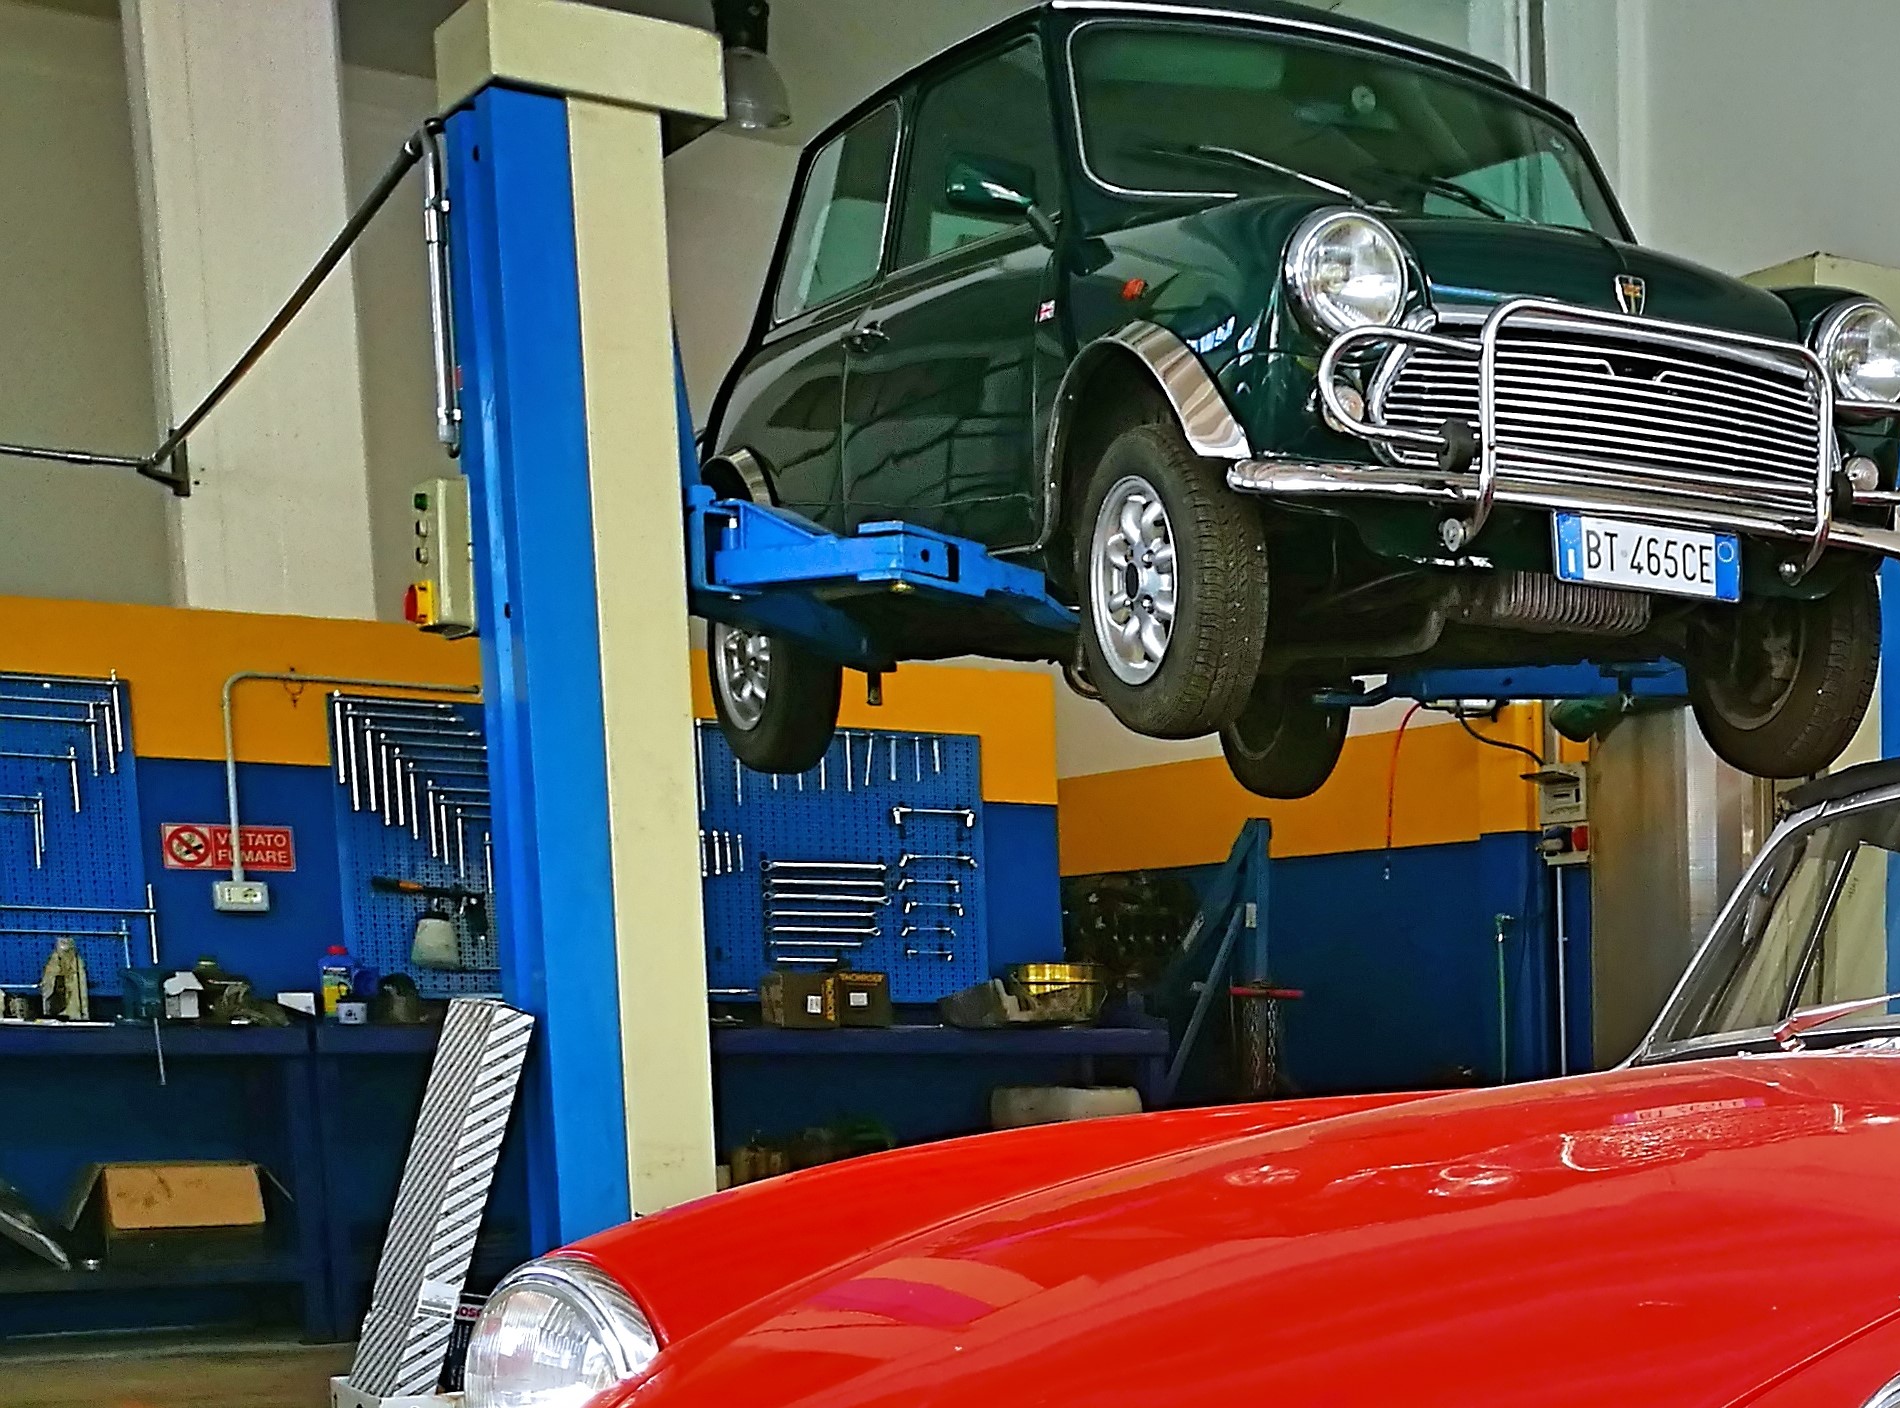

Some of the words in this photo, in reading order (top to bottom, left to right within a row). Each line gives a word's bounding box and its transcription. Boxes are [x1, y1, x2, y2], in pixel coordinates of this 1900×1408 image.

[1585, 529, 1618, 572] BT
[1629, 534, 1714, 584] 465CE
[216, 832, 287, 848] VTATO
